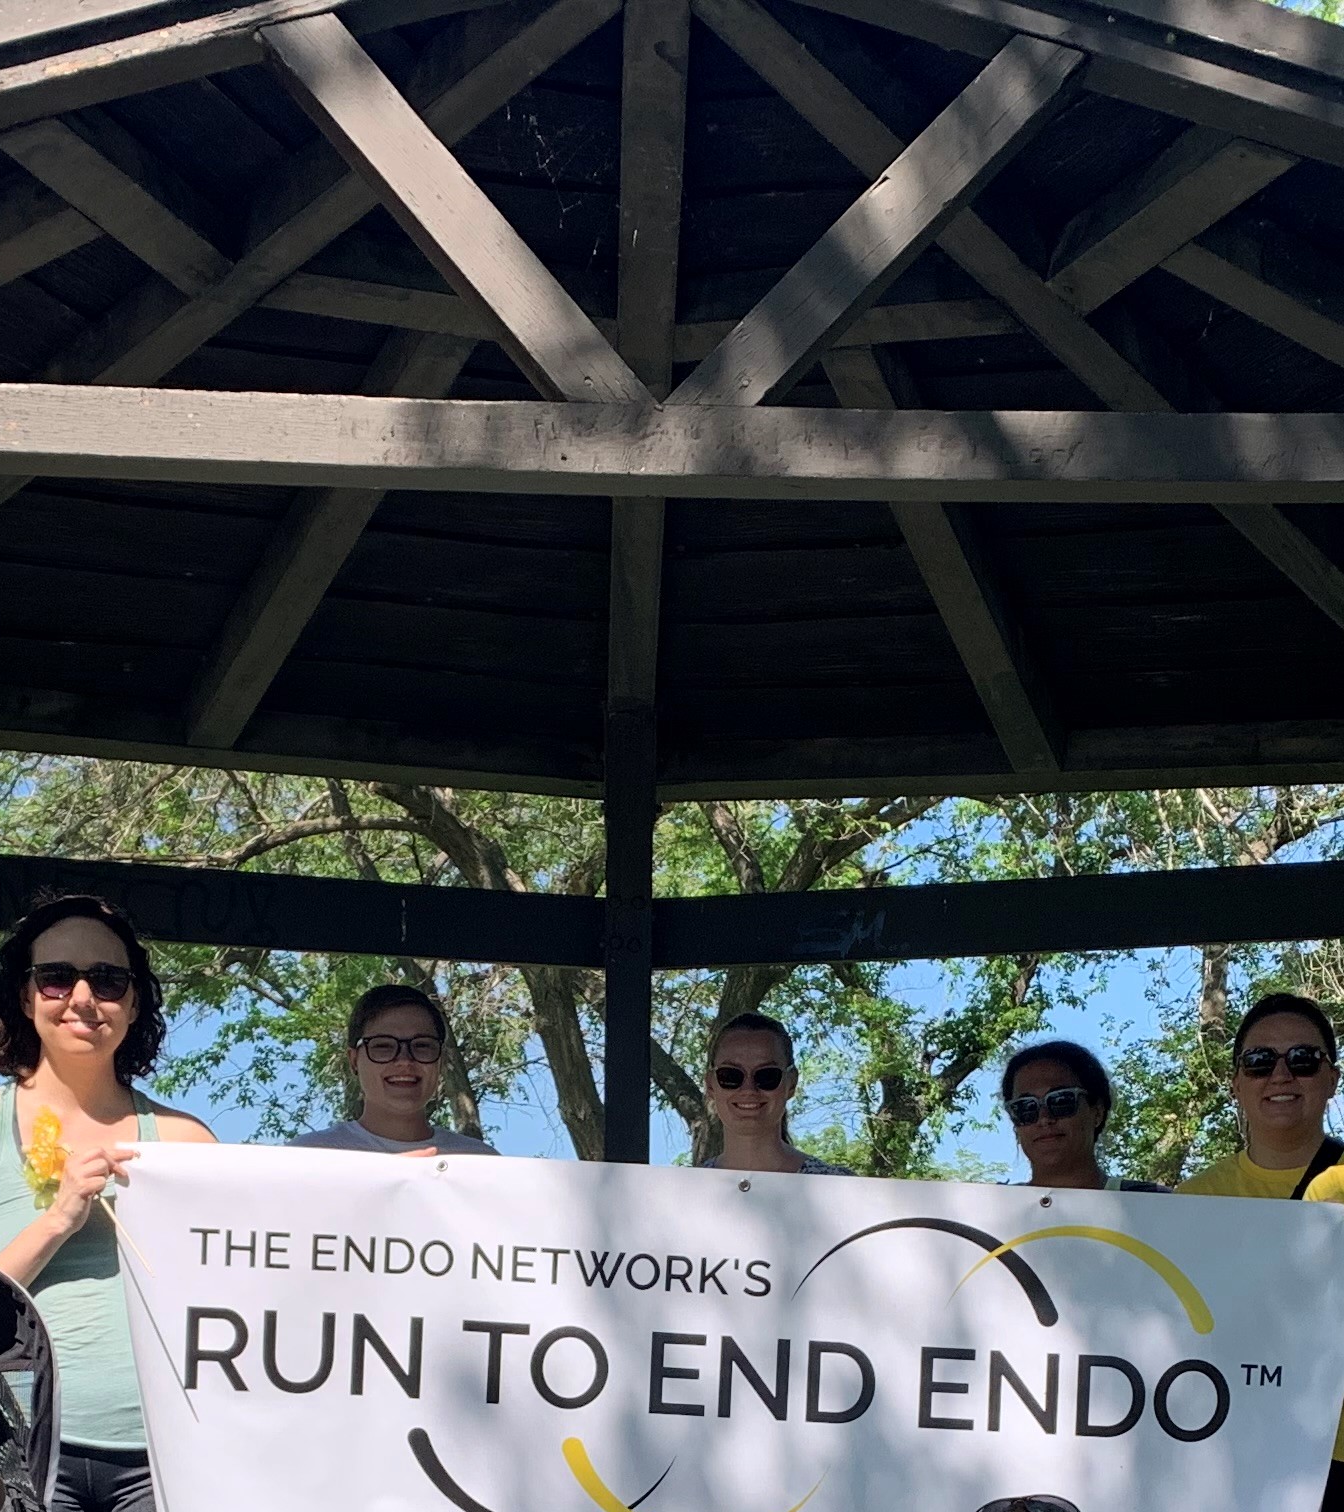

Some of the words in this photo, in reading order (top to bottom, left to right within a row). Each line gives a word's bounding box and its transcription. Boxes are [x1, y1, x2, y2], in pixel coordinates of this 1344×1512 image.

[189, 1227, 291, 1269] THE
[311, 1233, 454, 1277] ENDO
[471, 1242, 772, 1298] NETWORK'S
[184, 1306, 424, 1399] RUN
[462, 1319, 609, 1410] TO
[648, 1331, 876, 1424] END
